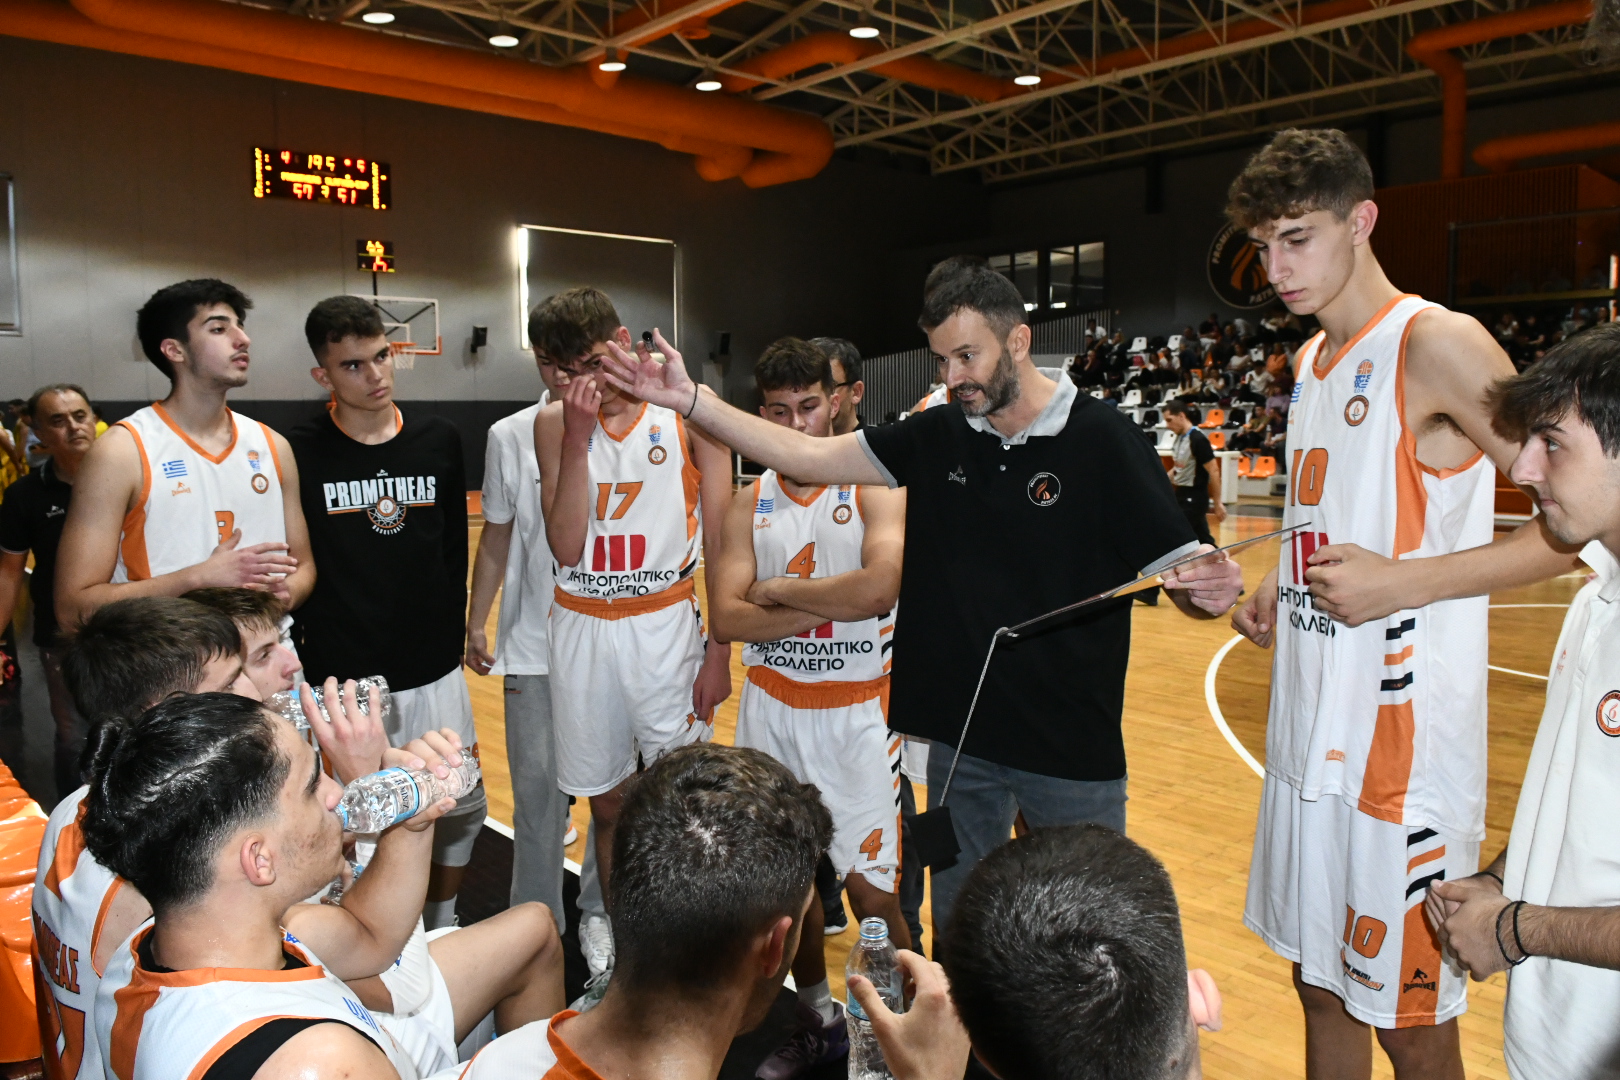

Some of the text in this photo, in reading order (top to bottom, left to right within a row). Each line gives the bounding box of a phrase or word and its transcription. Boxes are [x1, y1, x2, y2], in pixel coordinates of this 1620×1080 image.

[322, 475, 436, 508] PROMITHEAS
[1290, 447, 1329, 506] 10
[596, 481, 644, 521] 17
[785, 541, 816, 579] 4
[763, 653, 845, 671] ΚΟΛΛΕΓΙΟ
[859, 827, 884, 861] 4
[1342, 902, 1388, 959] 10
